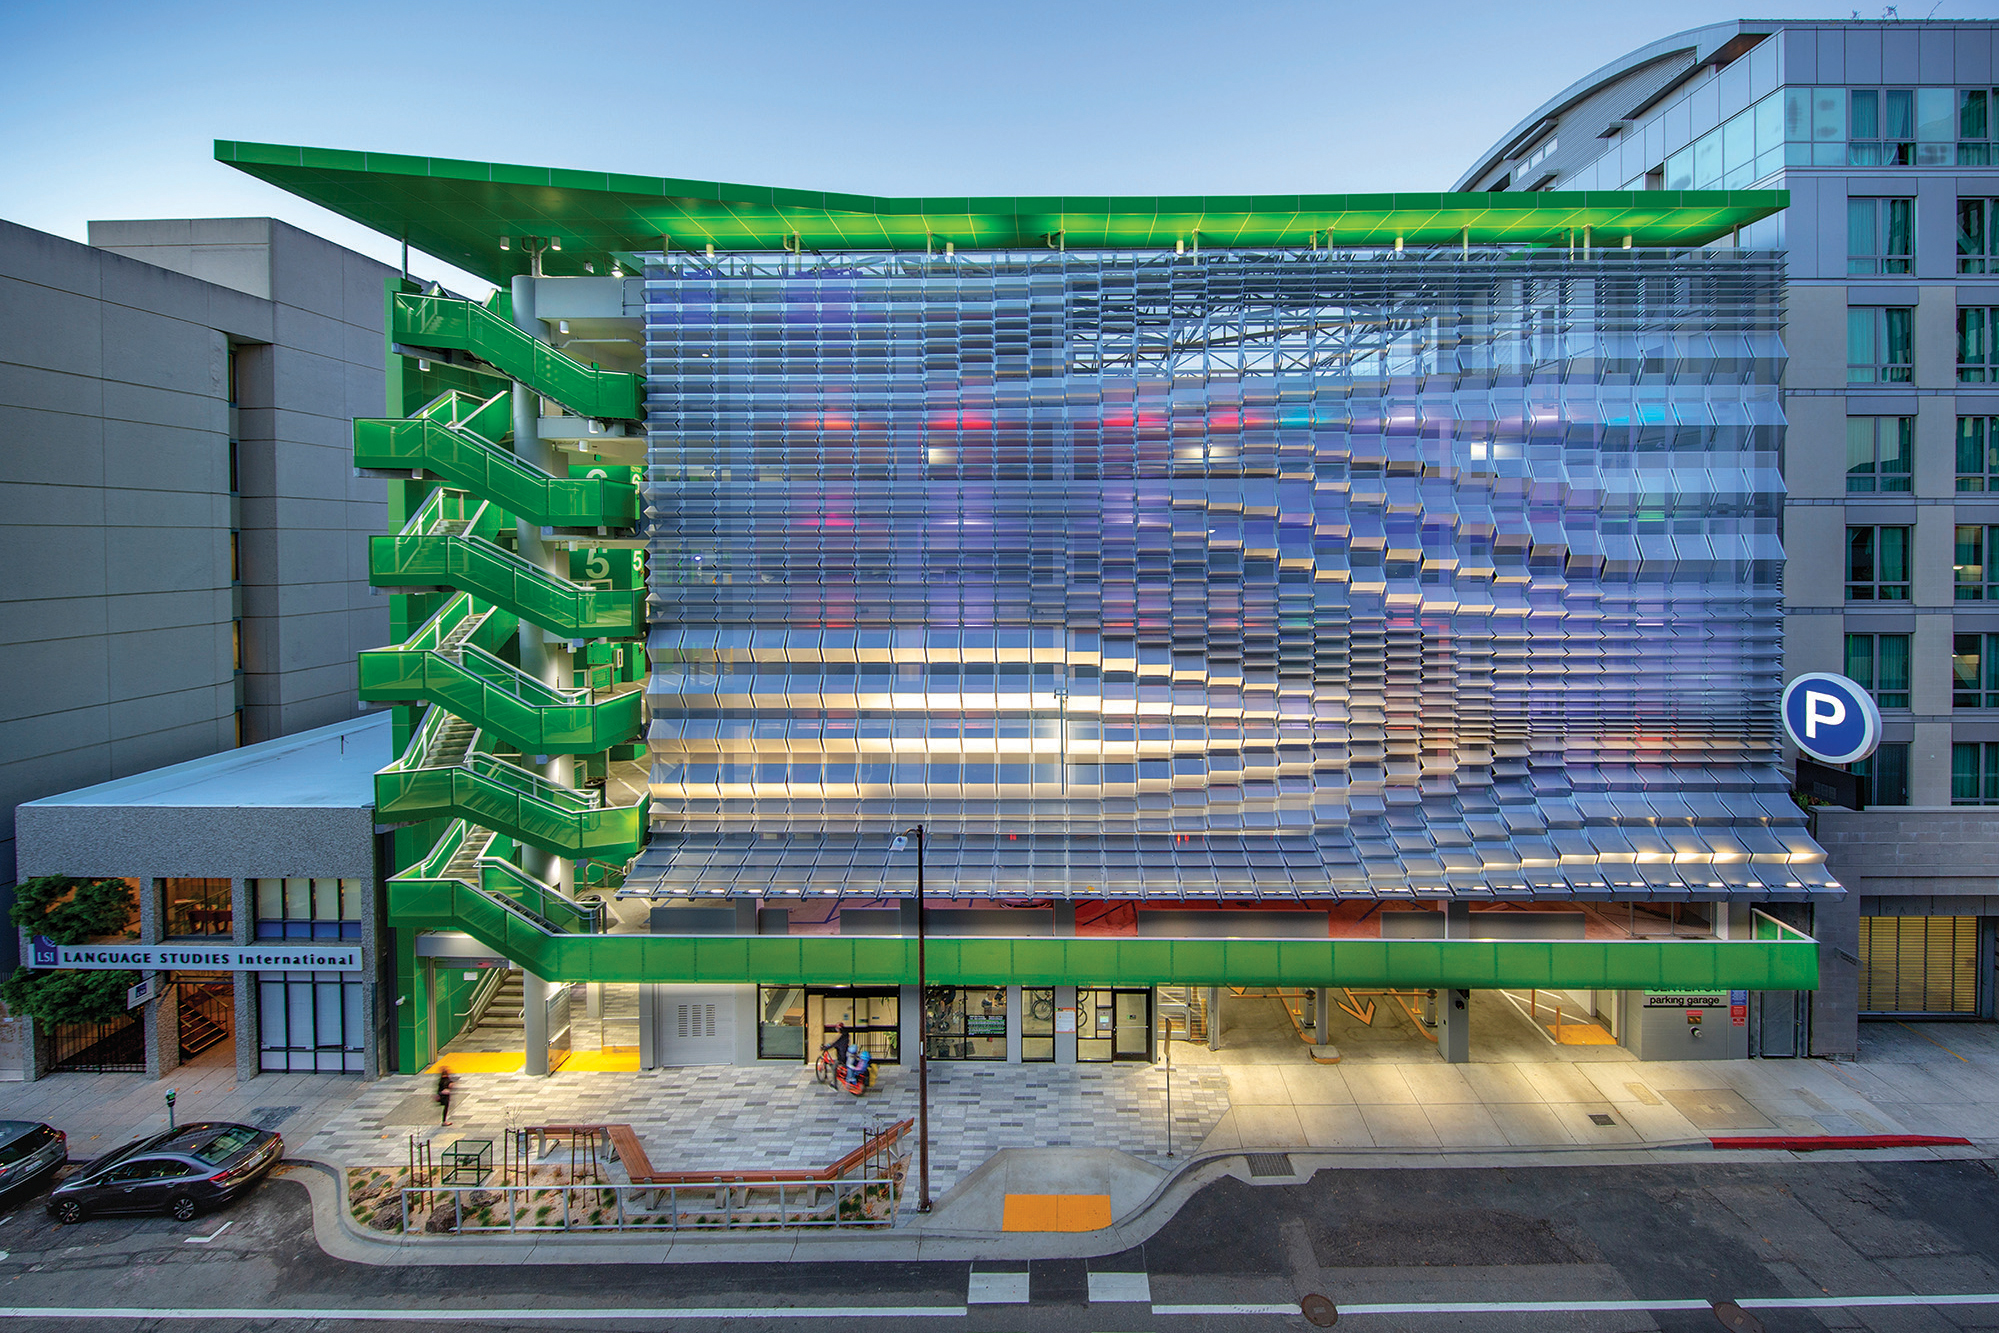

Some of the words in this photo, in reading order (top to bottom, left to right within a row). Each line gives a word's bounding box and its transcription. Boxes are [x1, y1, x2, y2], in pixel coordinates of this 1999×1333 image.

[585, 548, 610, 579] 5
[632, 550, 642, 571] 5
[1806, 690, 1846, 739] P
[37, 951, 55, 963] LSI
[63, 952, 152, 963] LANGUAGE
[160, 953, 230, 964] STUDIES
[238, 953, 354, 965] International
[1649, 995, 1685, 1006] parking
[1686, 997, 1720, 1006] garage
